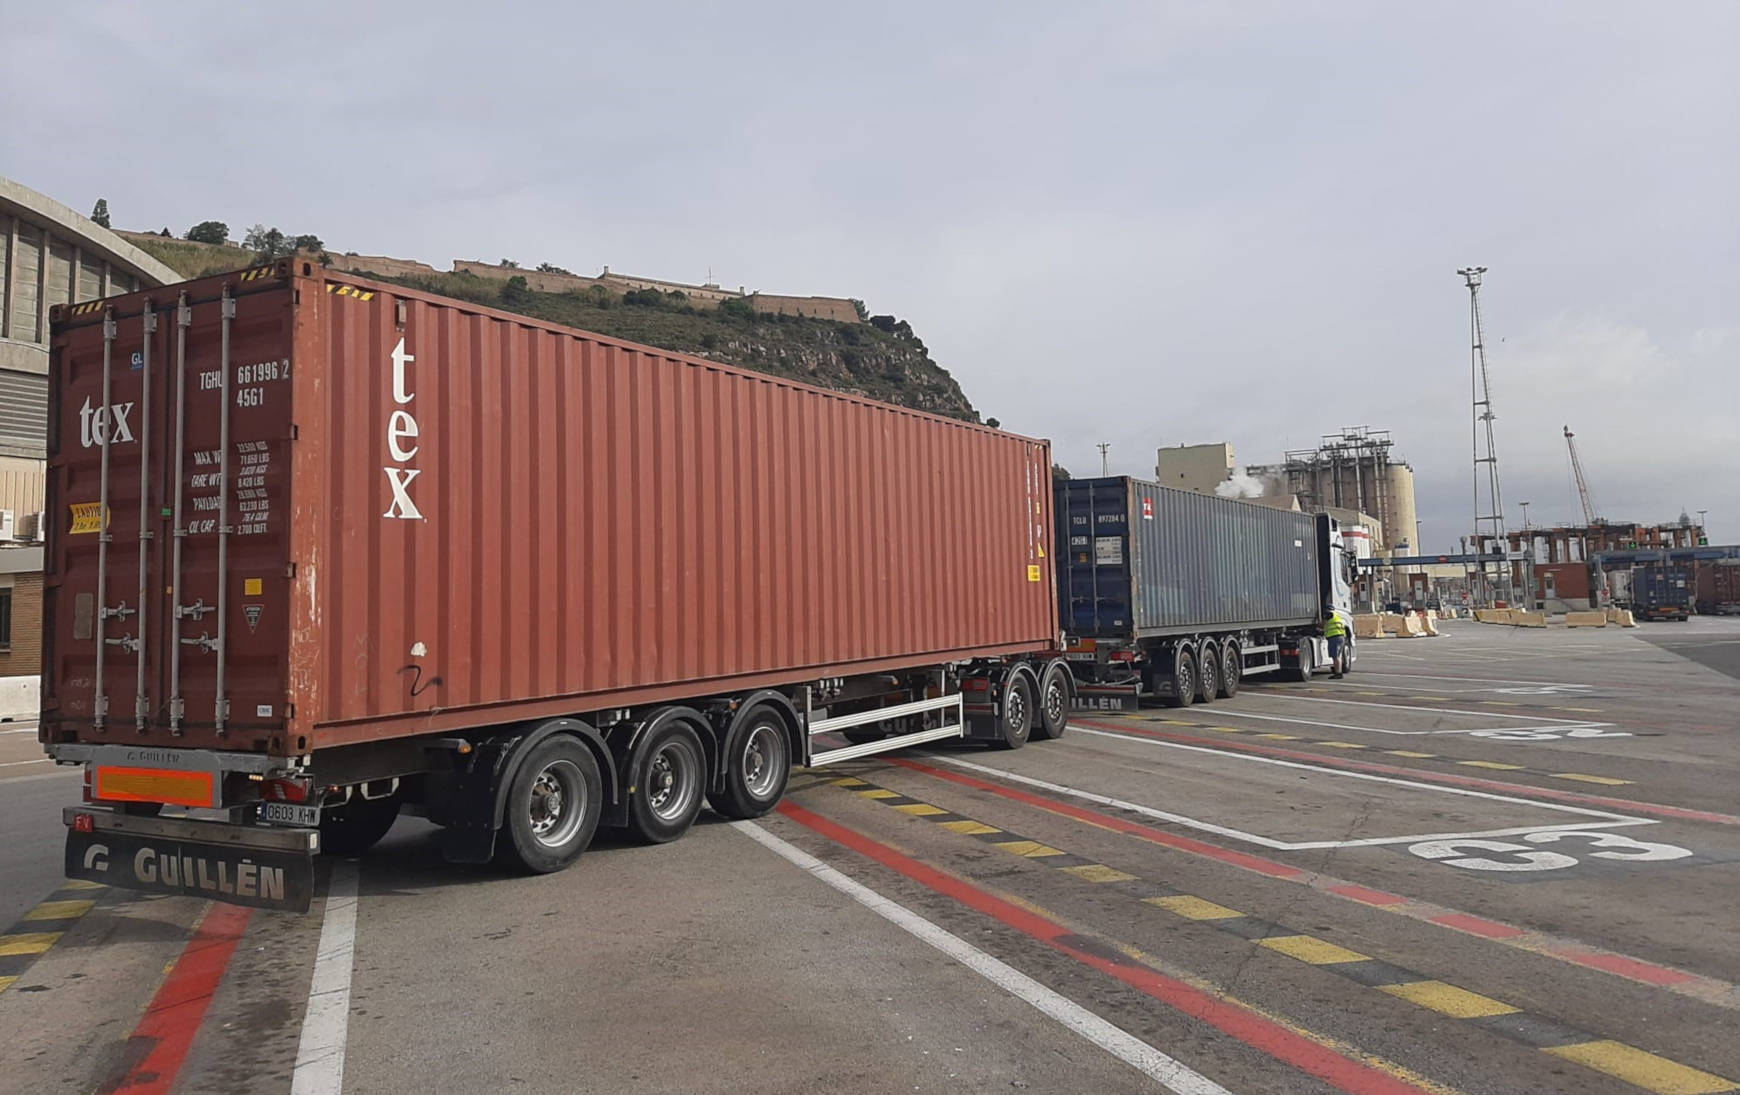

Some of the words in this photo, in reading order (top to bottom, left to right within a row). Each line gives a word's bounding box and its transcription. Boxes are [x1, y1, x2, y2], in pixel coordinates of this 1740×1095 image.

[238, 361, 278, 384] 661996
[281, 359, 289, 379] 2
[237, 387, 263, 407] 45G1
[80, 395, 134, 448] tex
[1071, 696, 1122, 710] ILLÉN
[268, 804, 293, 820] 0603
